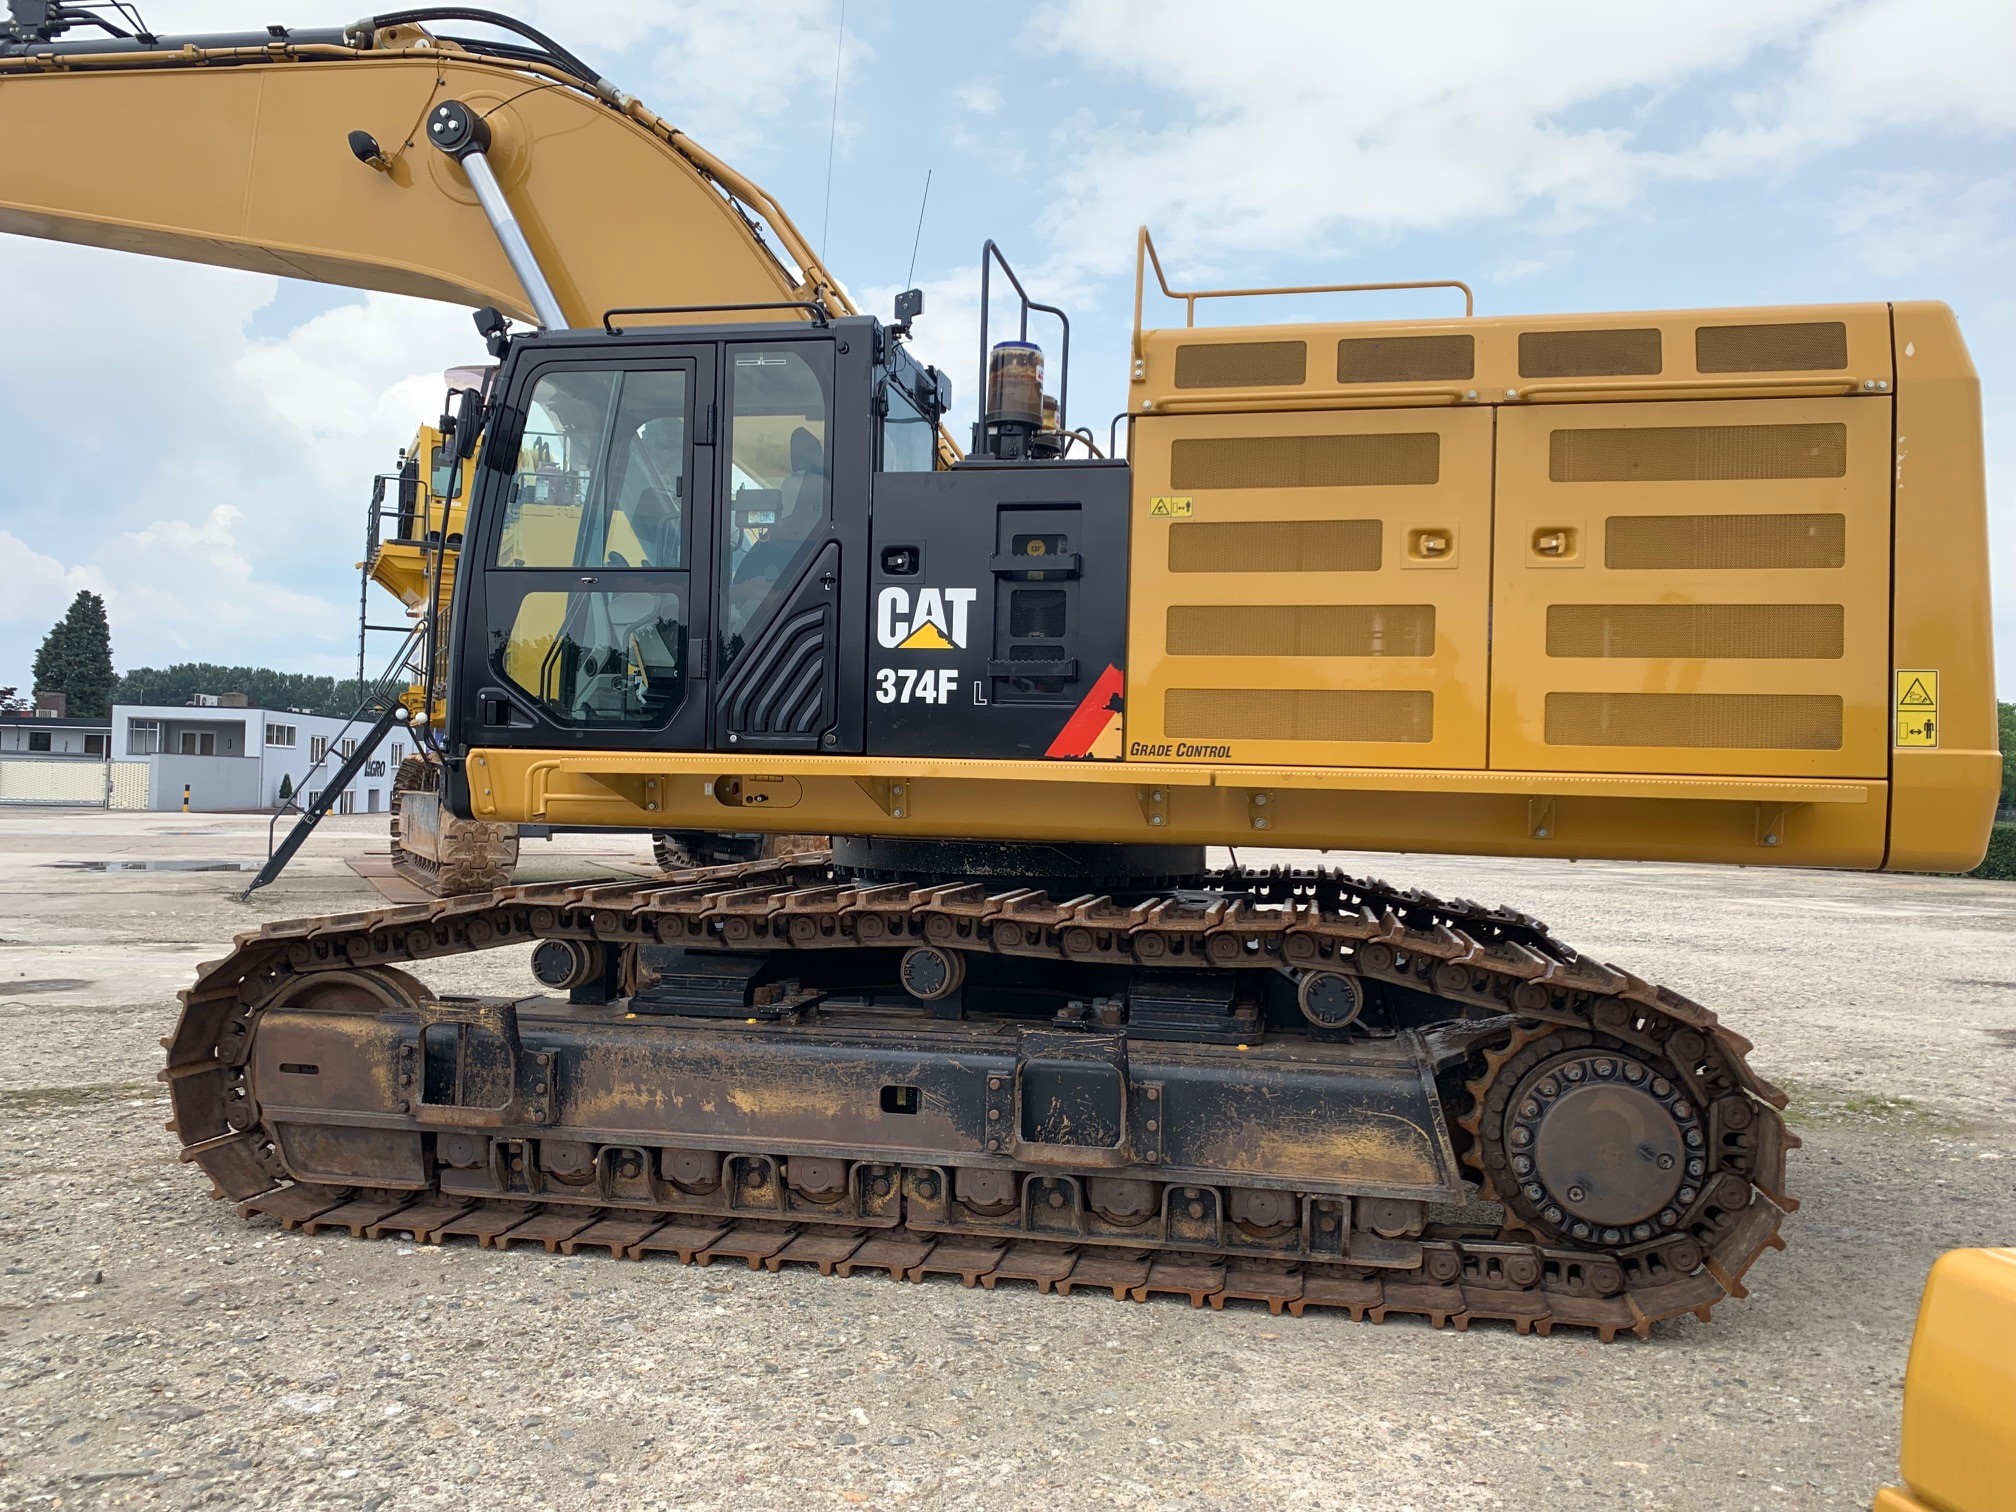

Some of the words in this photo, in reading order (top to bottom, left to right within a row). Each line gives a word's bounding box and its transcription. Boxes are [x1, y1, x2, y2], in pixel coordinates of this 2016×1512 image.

[877, 586, 977, 649] CAT
[875, 668, 959, 704] 374F
[973, 680, 988, 706] L
